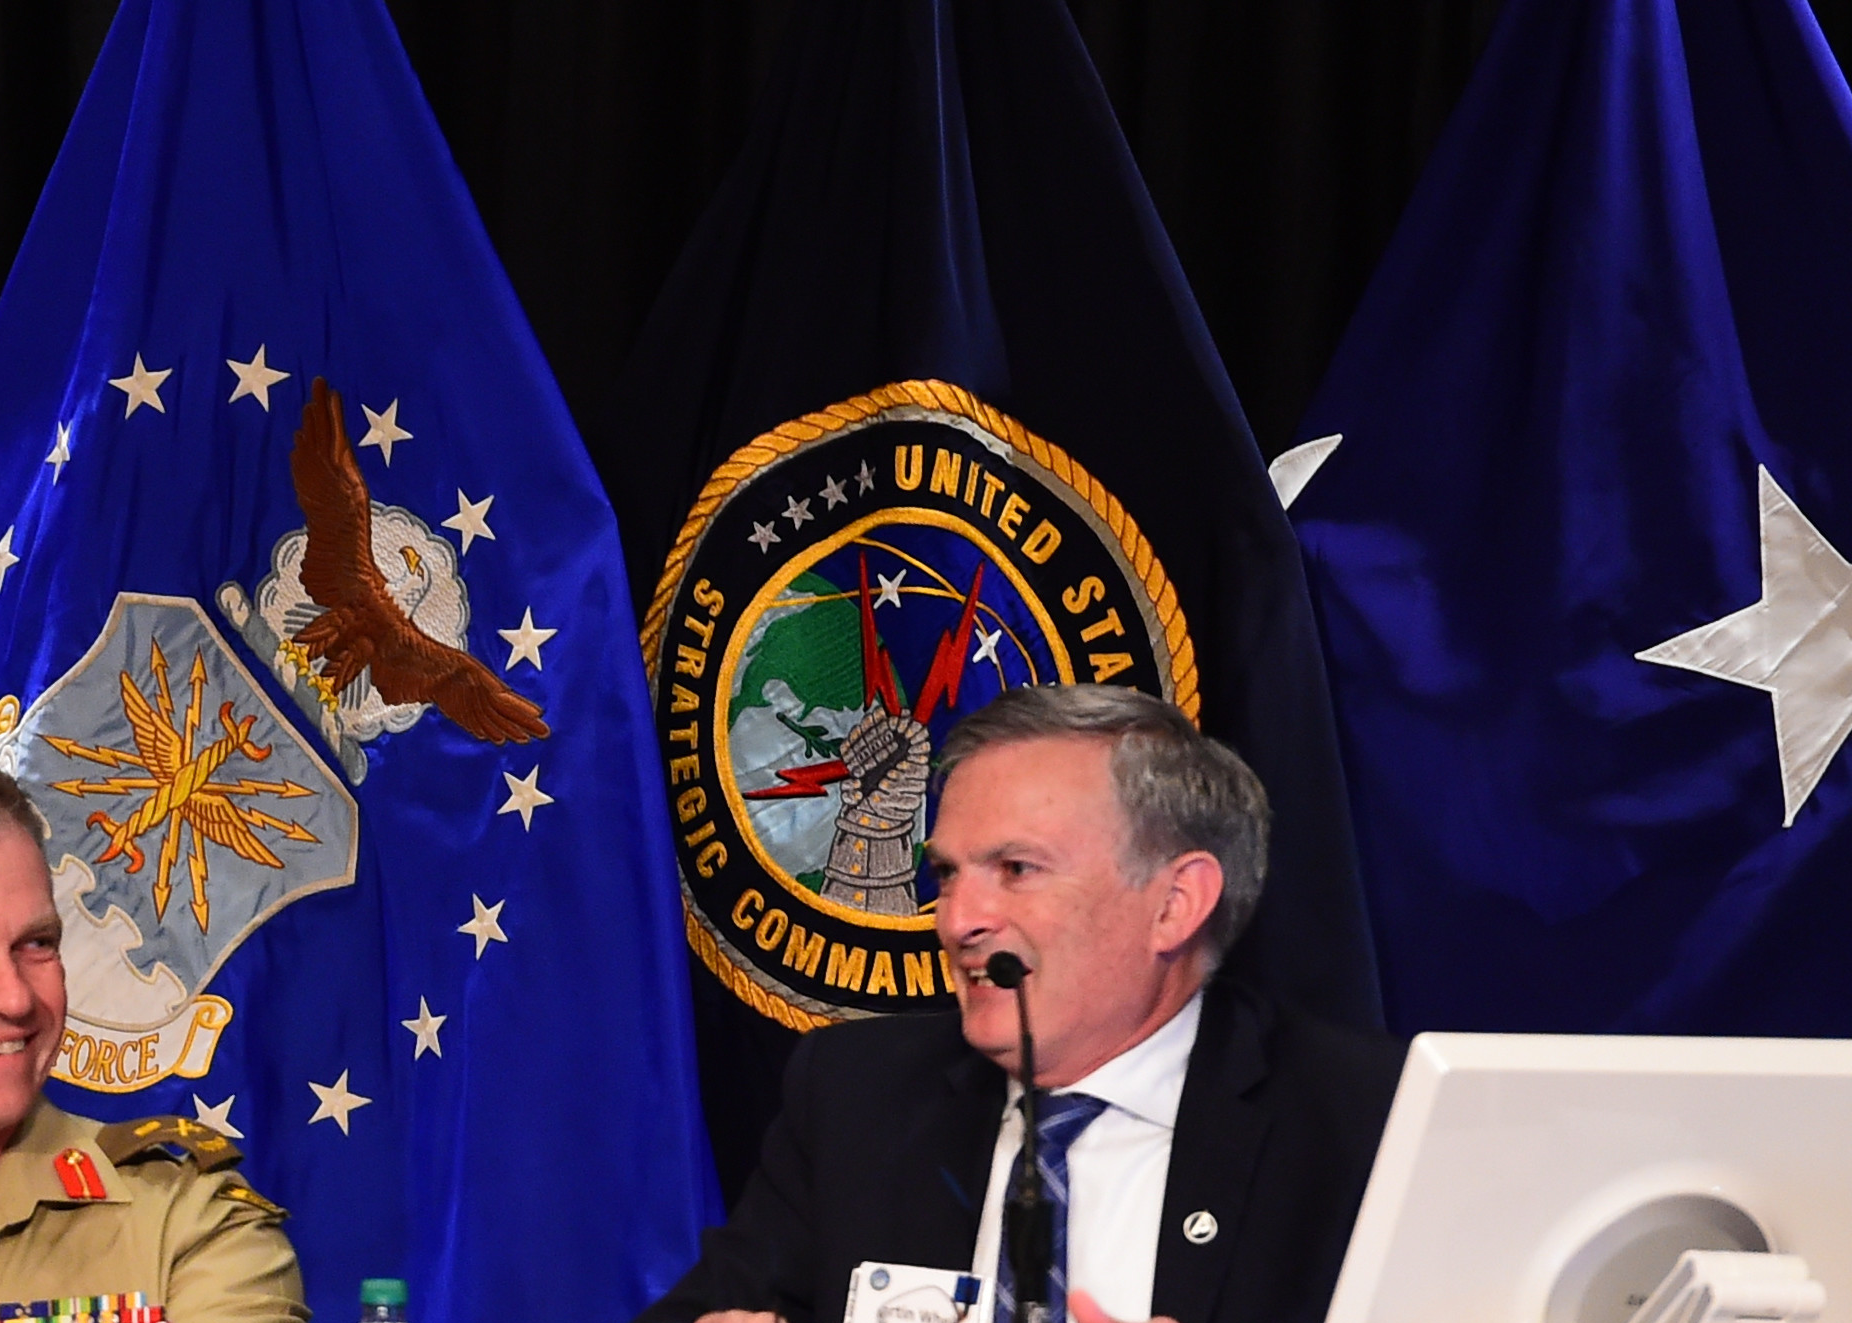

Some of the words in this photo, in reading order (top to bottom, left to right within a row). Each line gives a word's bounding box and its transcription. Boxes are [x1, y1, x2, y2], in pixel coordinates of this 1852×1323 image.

[894, 444, 1063, 565] UNITED
[1061, 575, 1138, 692] STA
[669, 578, 728, 879] STRATEGIC
